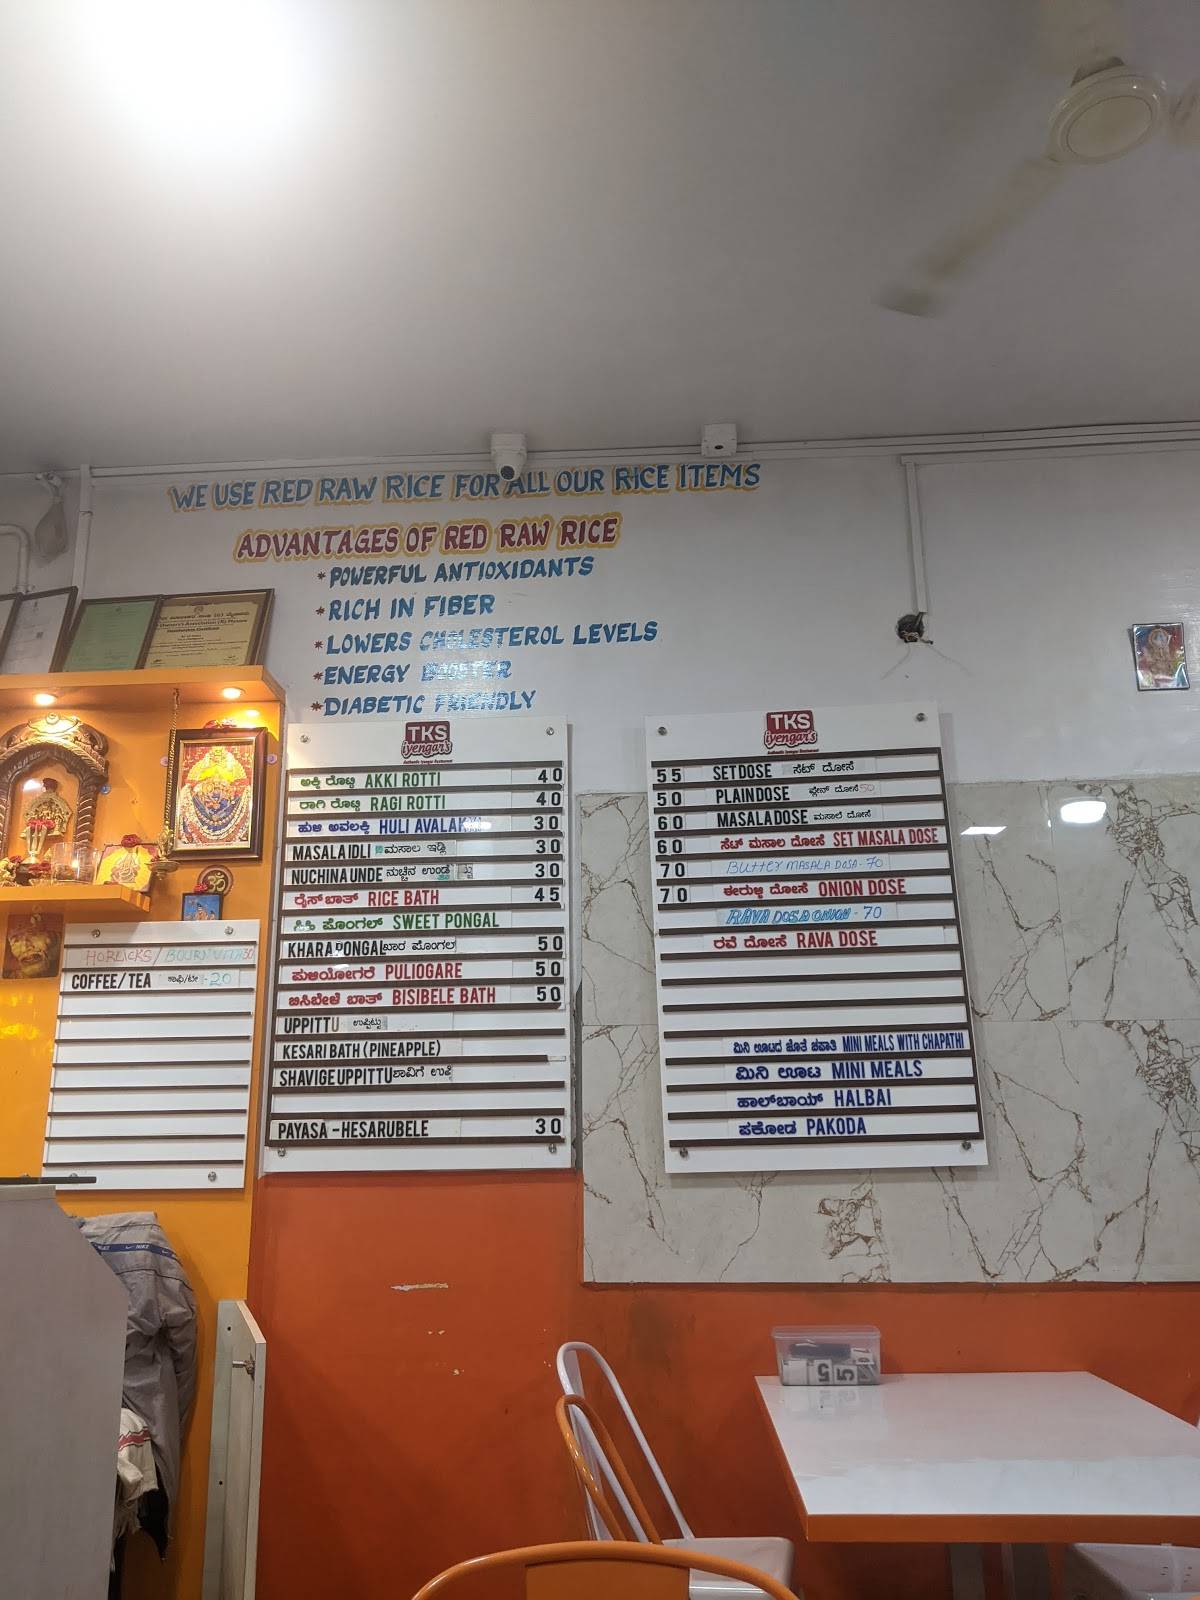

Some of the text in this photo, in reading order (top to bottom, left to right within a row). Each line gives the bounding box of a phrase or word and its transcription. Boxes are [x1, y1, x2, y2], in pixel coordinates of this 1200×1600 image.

[171, 463, 761, 509] WE USE RED RAW RICE FOR ALL OUR RICE ITEMS
[237, 517, 618, 558] ADVANTAGES OF RED RAW RICE
[329, 556, 595, 588] POWERFUL ANTIOXIDANTS
[328, 594, 495, 622] RICH IN FIBER
[326, 621, 659, 655] LOWERS CHOLESTEROL LEVELS
[323, 664, 411, 685] ENERGY
[323, 690, 537, 717] DIABETIC FRIENDLY
[770, 713, 811, 730] TKS
[407, 725, 448, 742] TKS
[300, 776, 321, 789] ಅಕ್ಕಿ
[365, 773, 398, 788] AKKI
[402, 772, 441, 787] ROTTI
[299, 799, 326, 810] ರಾಗಿ
[371, 796, 402, 811] RAGI
[407, 795, 446, 810] ROTTI
[379, 818, 410, 834] HULI
[833, 827, 939, 847] SET MASALA DOSE
[786, 859, 831, 871] MASALA
[292, 867, 383, 884] NUCHINA UNDE
[818, 879, 907, 897] ONION DOSE
[368, 891, 399, 906] RICE
[404, 889, 439, 906] BATH
[393, 912, 499, 929] SWEET PONGAL
[726, 909, 770, 924] RAVA
[863, 906, 882, 919] 70
[797, 930, 878, 948] RAVA DOSE
[288, 941, 333, 957] KHARA
[385, 963, 463, 980] PULIOGARE
[71, 972, 151, 990] COFFEE/TEA
[392, 988, 455, 1006] BISIBELE
[460, 987, 496, 1003] BATH
[284, 1017, 340, 1034] UPPITTU
[283, 1044, 328, 1059] KESARI
[330, 1043, 360, 1058] BATH
[842, 1032, 964, 1052] MINI MEALS WITH CHAPATHI
[280, 1067, 393, 1086] SHAVIGE UPPITTU
[831, 1060, 923, 1080] MINI MEALS
[834, 1088, 892, 1107] HALBAI
[278, 1122, 328, 1139] PAYASA
[806, 1117, 867, 1135] PAKODA
